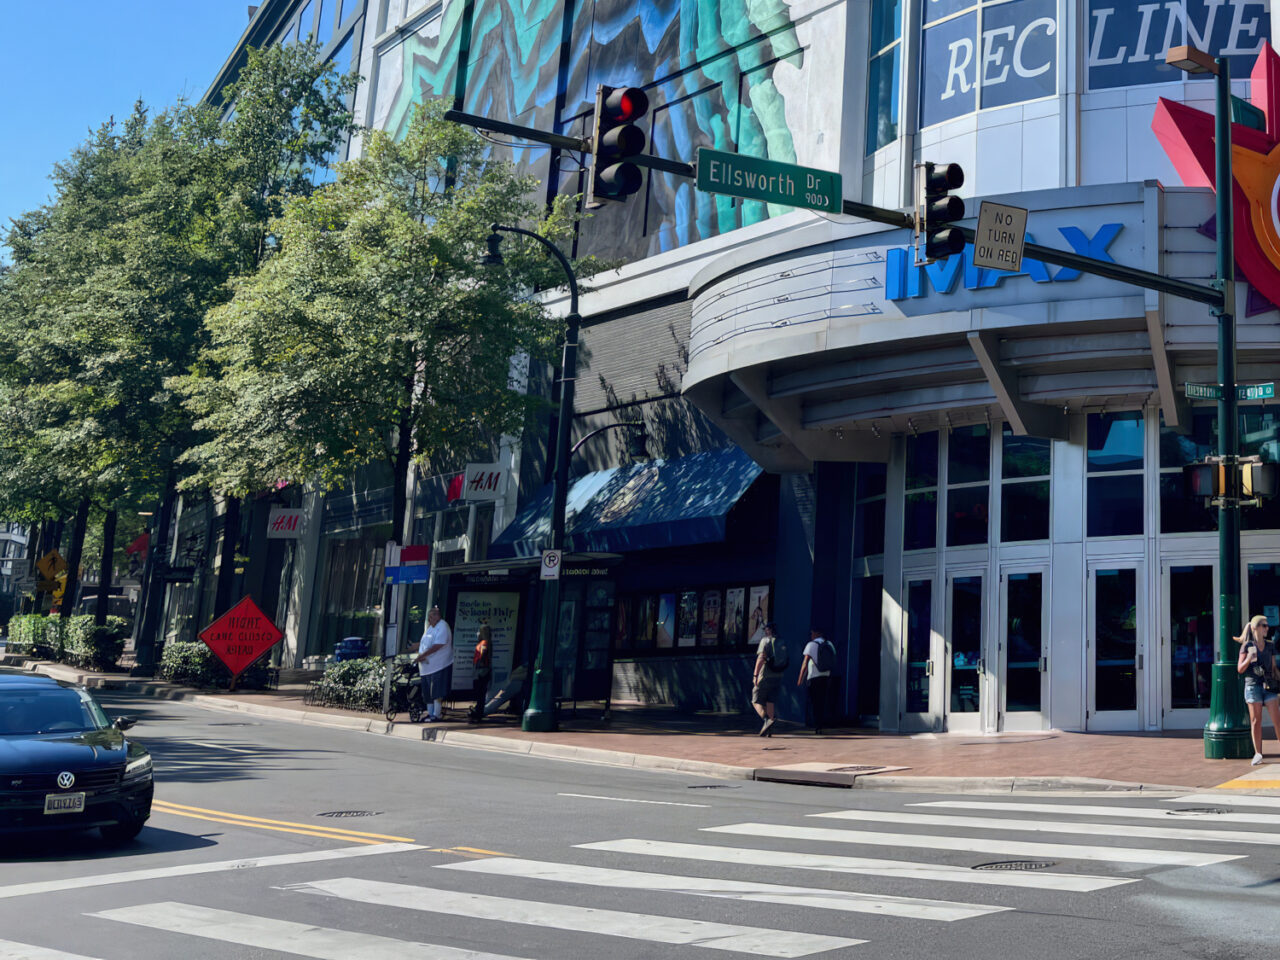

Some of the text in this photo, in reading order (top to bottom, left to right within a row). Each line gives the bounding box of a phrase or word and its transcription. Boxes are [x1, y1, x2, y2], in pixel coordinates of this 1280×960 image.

[709, 159, 821, 196] Ellsworth Dr
[805, 192, 822, 206] 900
[995, 212, 1013, 226] NO
[988, 228, 1016, 245] TURN
[978, 246, 1018, 264] ON RED
